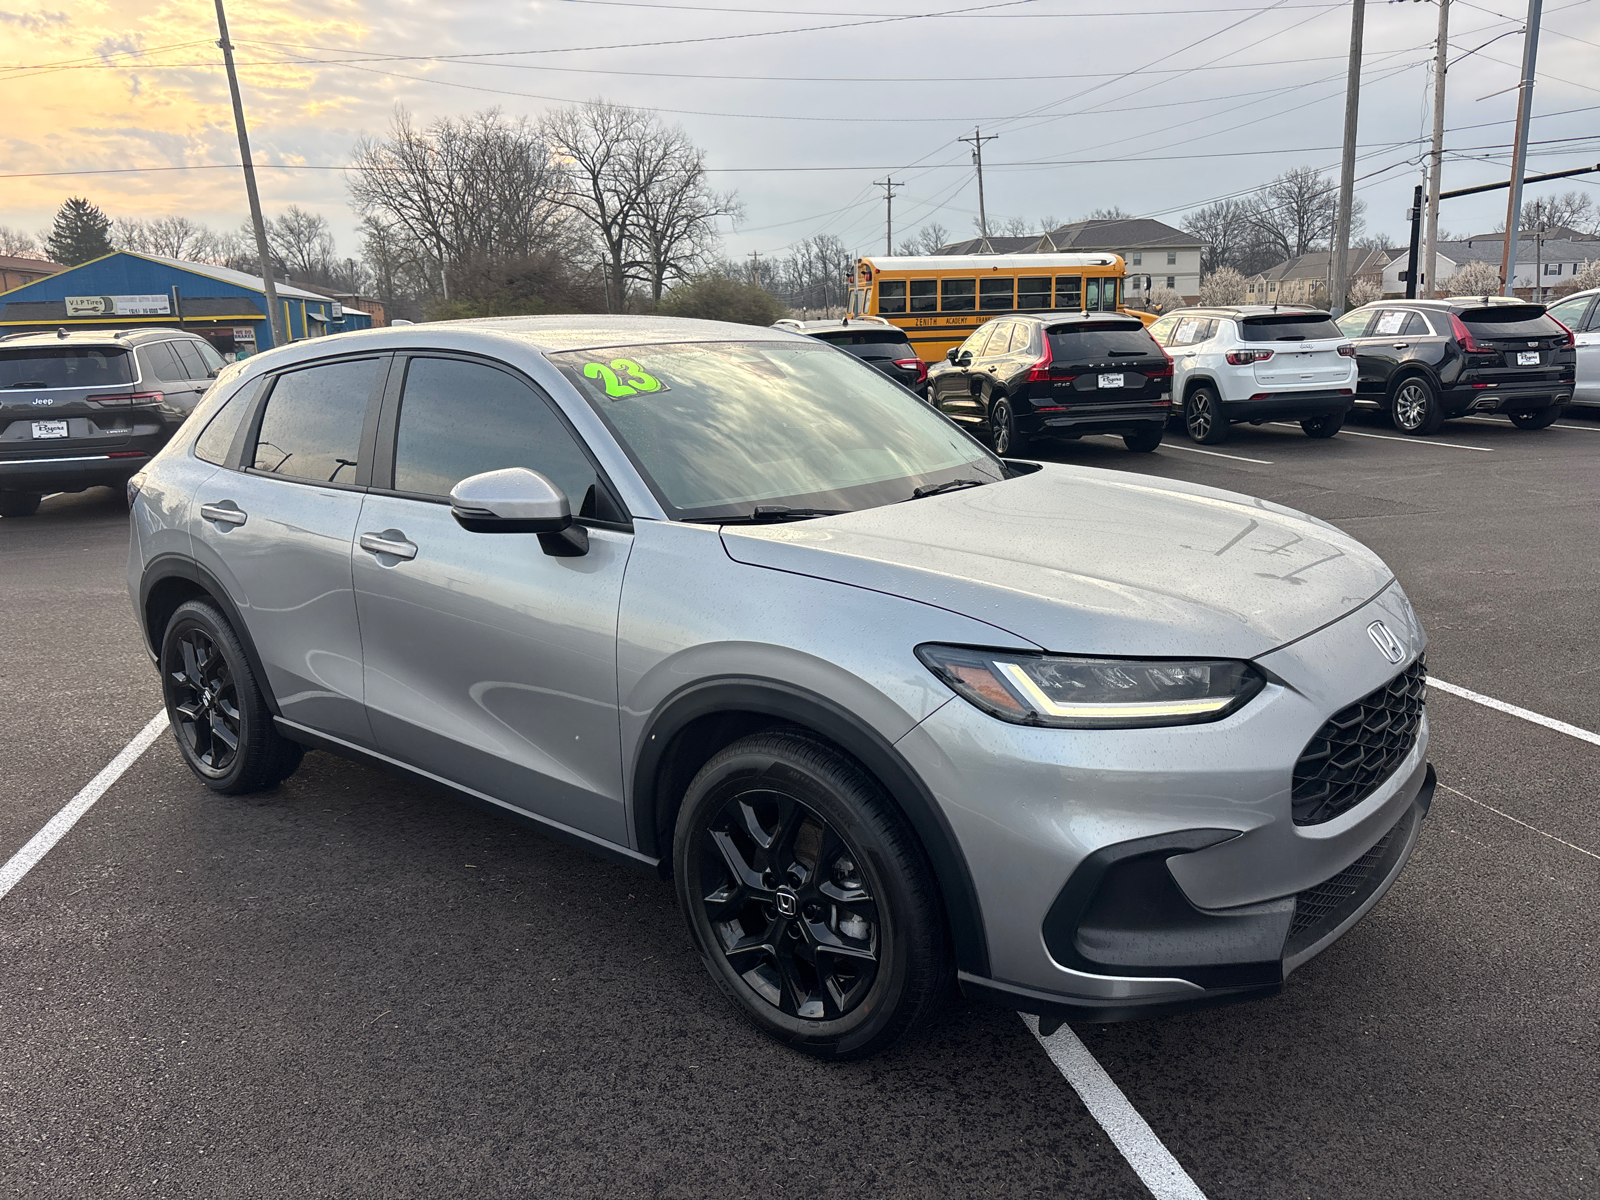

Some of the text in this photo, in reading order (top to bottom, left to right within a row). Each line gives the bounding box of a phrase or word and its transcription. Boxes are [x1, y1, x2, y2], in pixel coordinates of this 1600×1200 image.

[86, 298, 103, 306] Tires
[915, 317, 938, 327] ZENITH
[945, 317, 968, 325] ACADEMY
[583, 358, 662, 398] 23
[32, 398, 54, 406] Jeep
